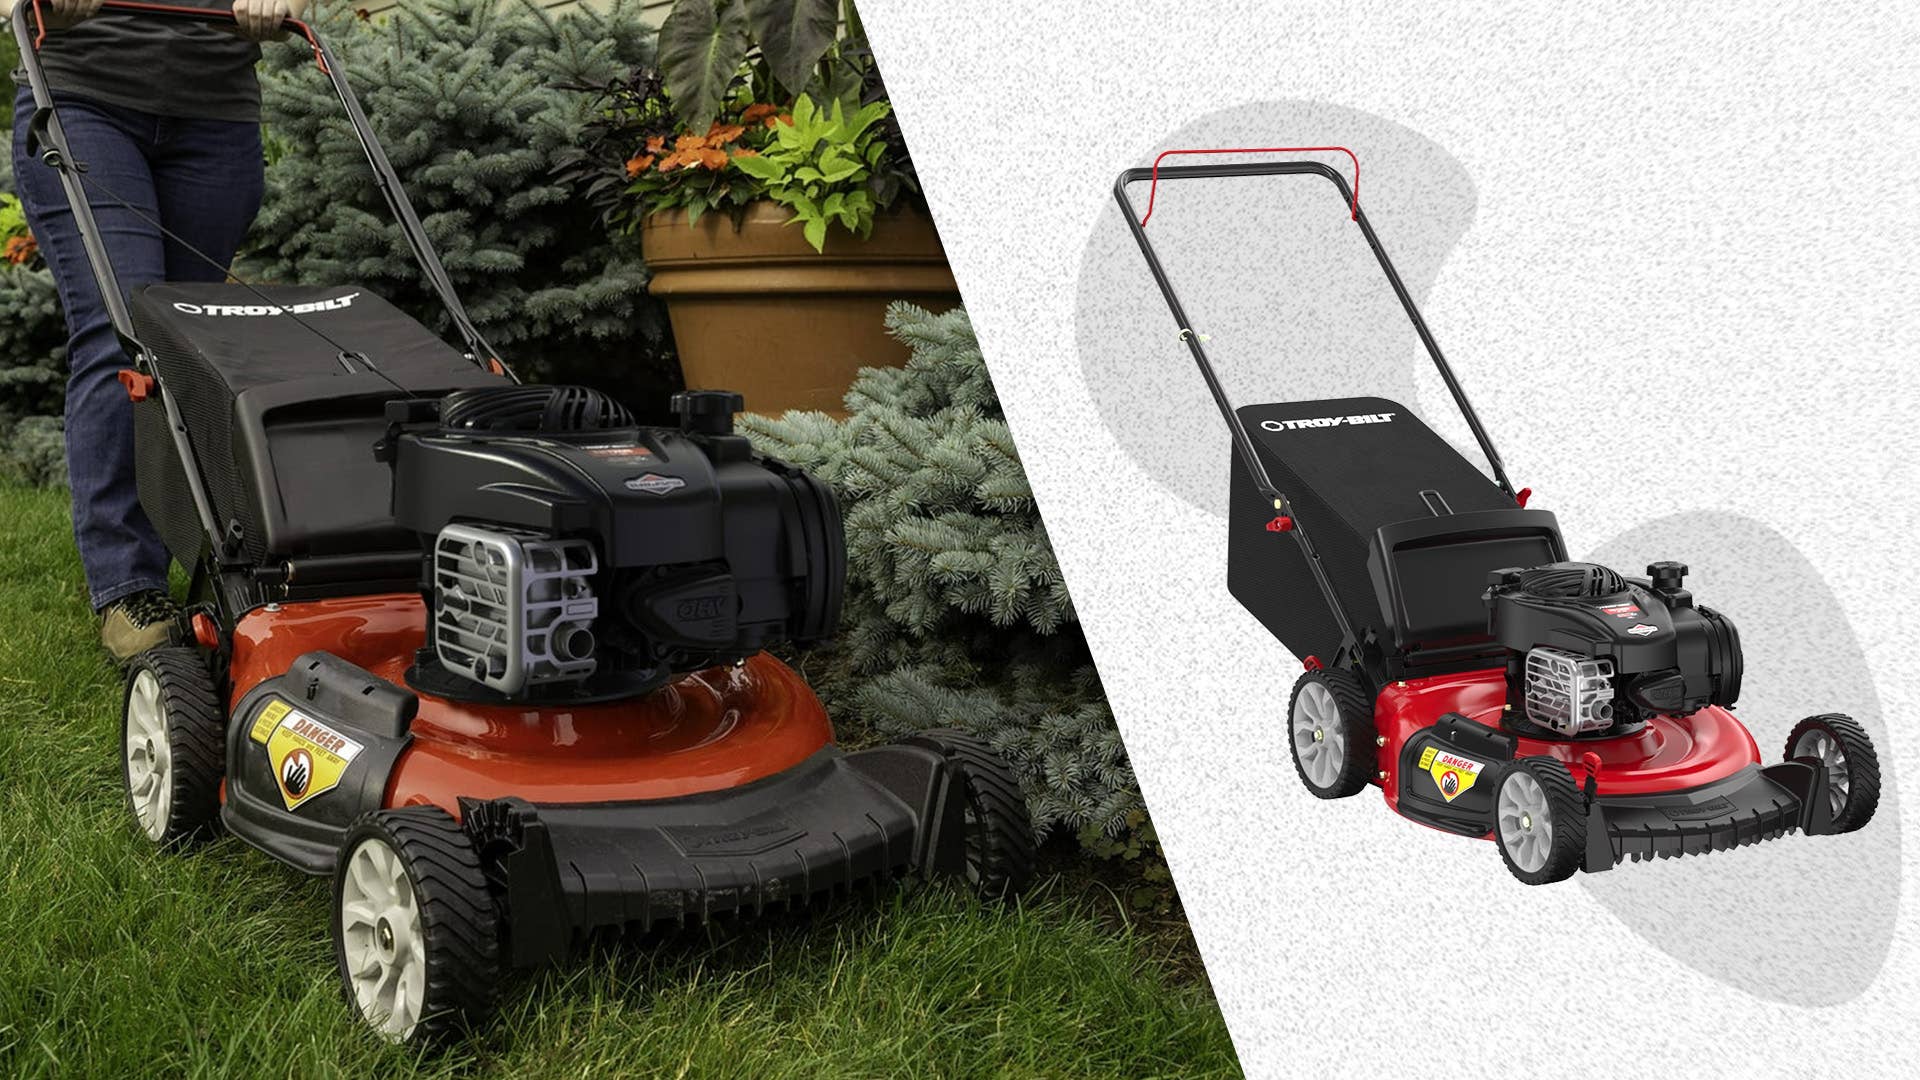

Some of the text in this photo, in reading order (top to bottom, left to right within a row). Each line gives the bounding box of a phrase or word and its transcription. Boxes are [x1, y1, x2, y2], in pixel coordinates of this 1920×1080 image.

[1282, 413, 1392, 430] TROY-BILT
[292, 719, 346, 753] DANGER
[1442, 755, 1474, 770] DANGER
